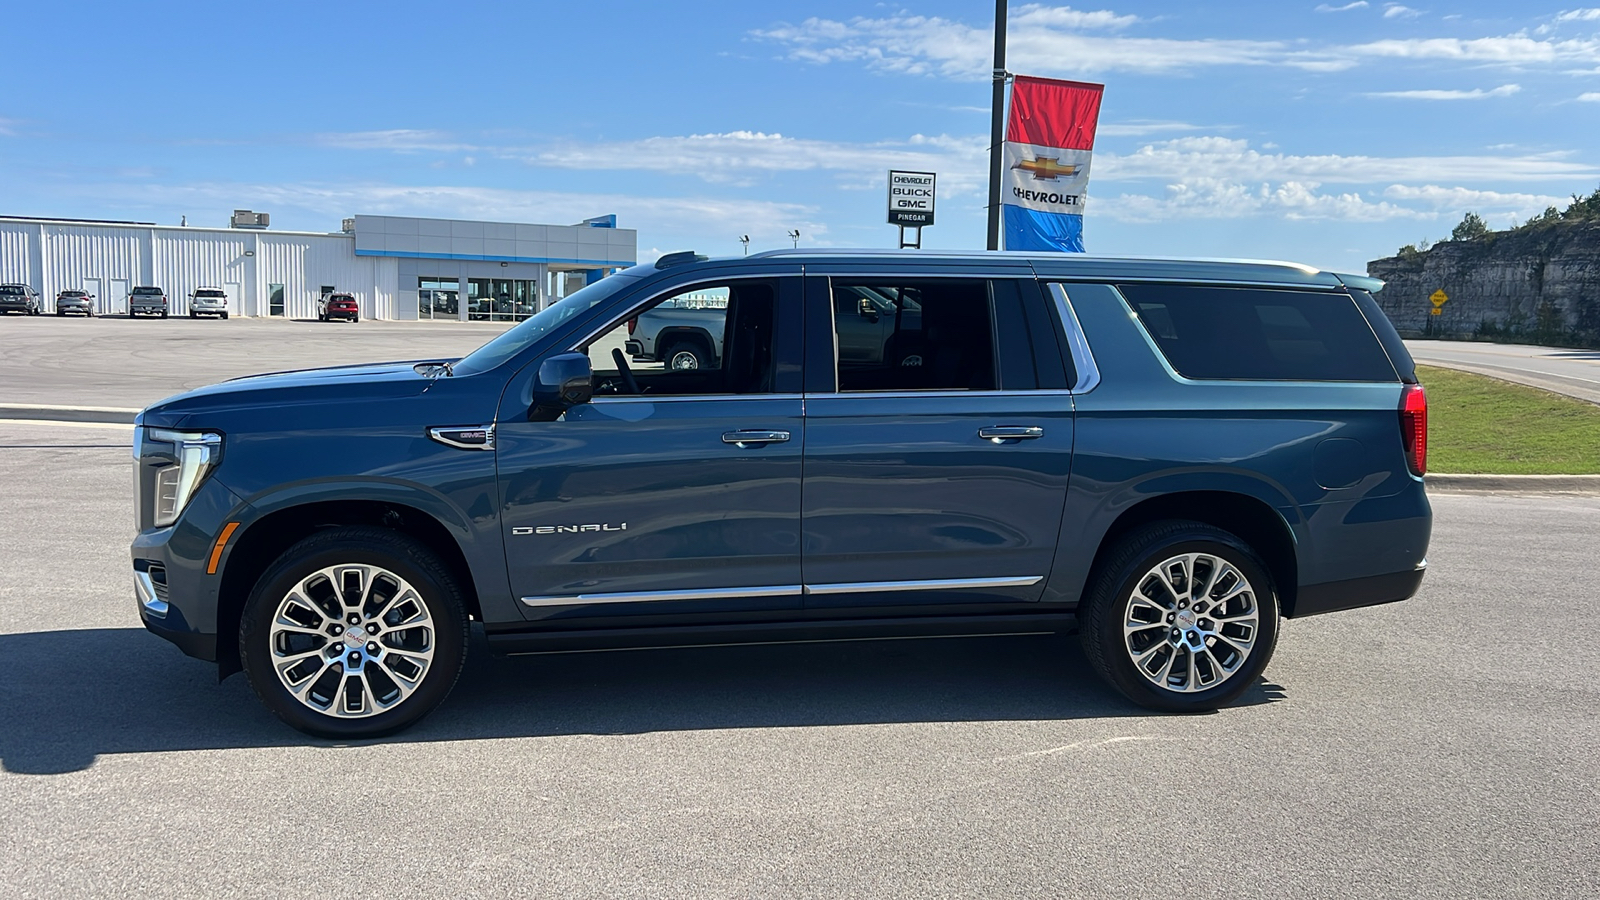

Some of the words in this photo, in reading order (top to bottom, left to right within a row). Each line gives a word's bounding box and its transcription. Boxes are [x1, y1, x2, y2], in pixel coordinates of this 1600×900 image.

[894, 176, 932, 185] CHEVROLET
[893, 187, 932, 197] BUICK
[1012, 187, 1079, 206] CHEVROLET
[898, 200, 927, 208] GMC
[897, 213, 926, 222] PINEGAR
[512, 522, 627, 535] DENALI
[1179, 614, 1194, 626] GMC
[346, 632, 364, 645] GMC
